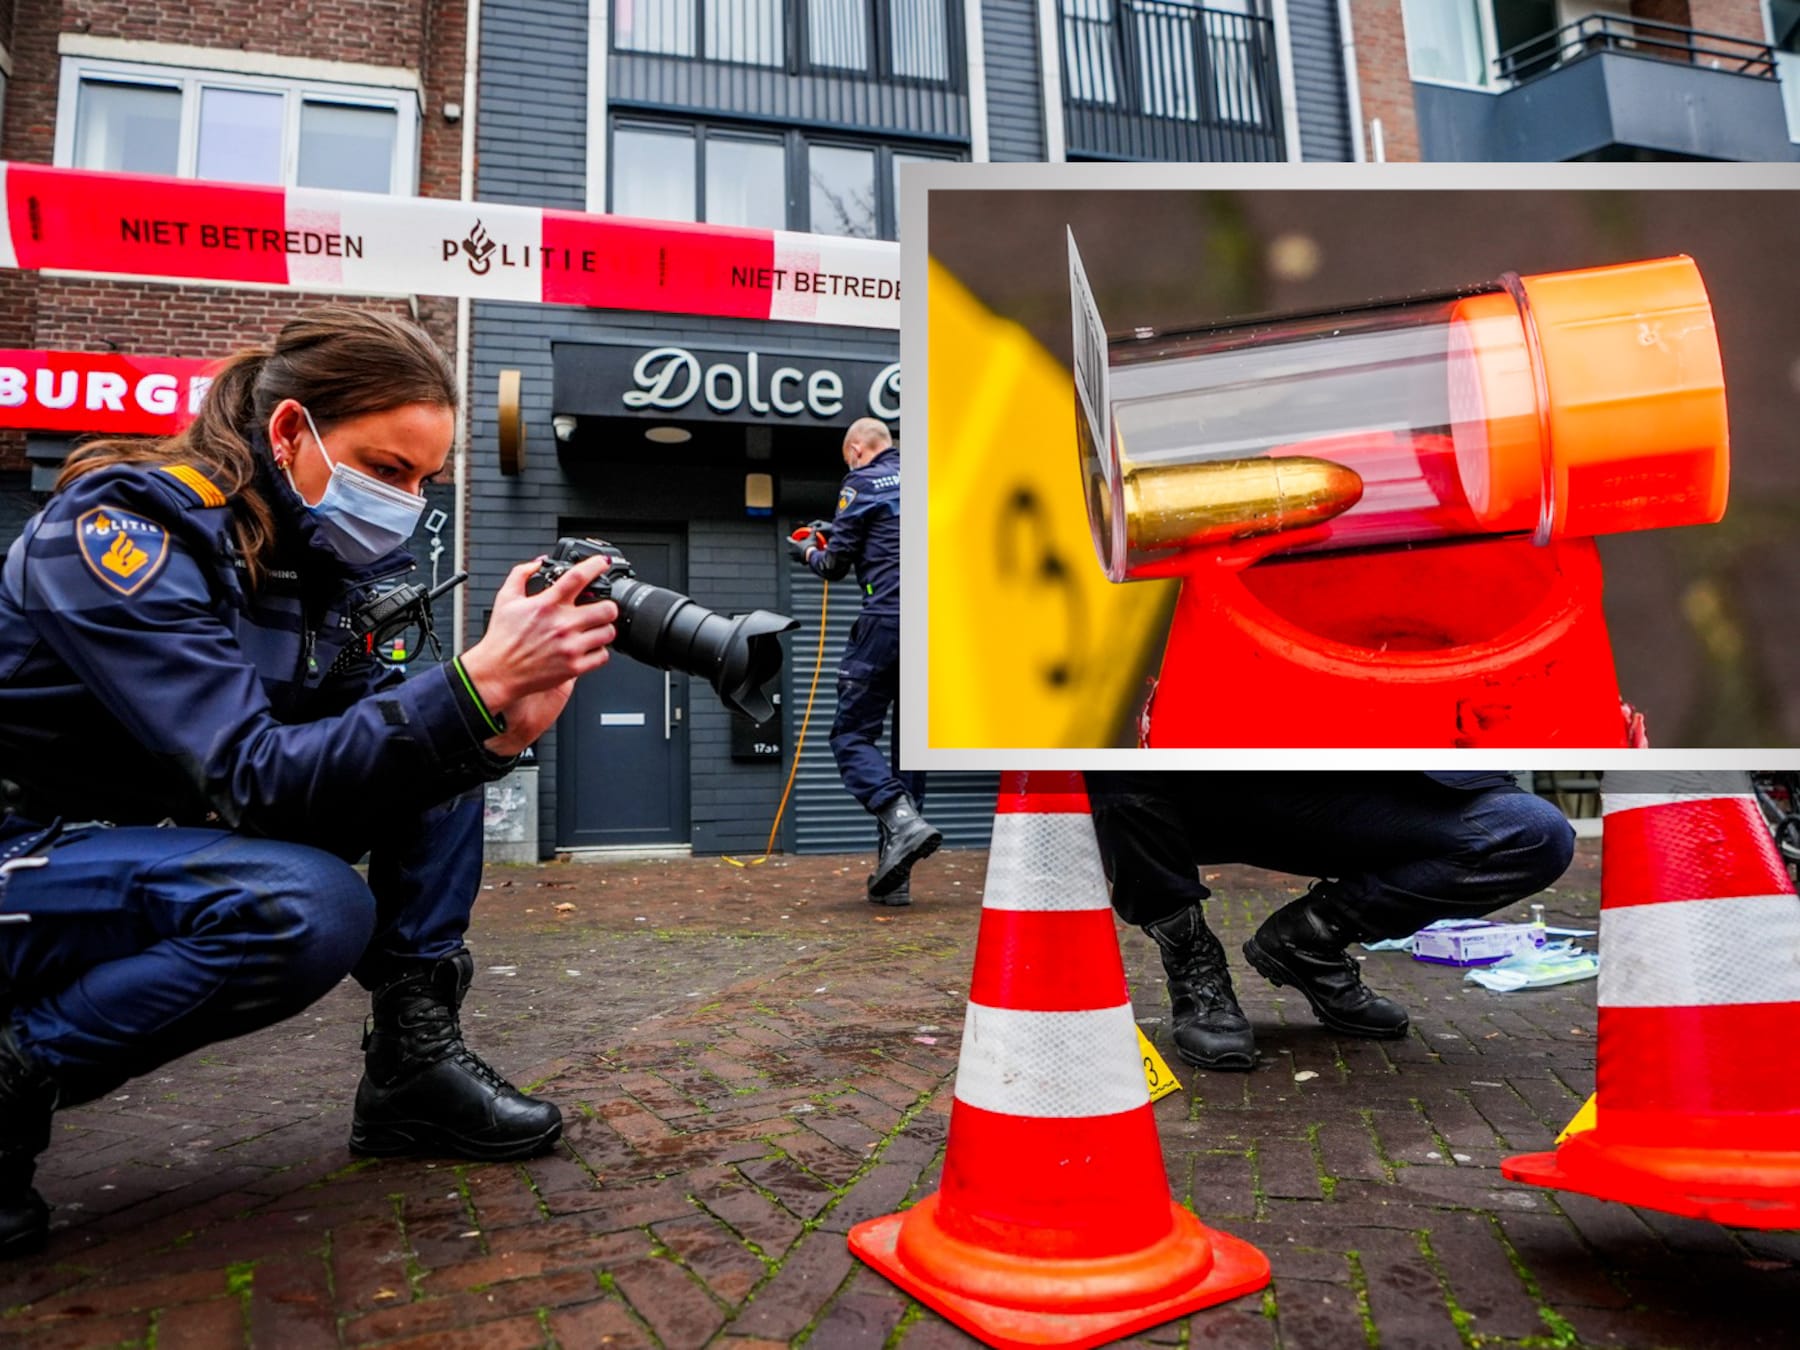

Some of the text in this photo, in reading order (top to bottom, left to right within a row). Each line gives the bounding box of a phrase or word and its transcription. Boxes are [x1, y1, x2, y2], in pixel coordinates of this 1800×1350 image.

[120, 218, 363, 259] NIET BETREDEN
[442, 234, 597, 276] POLITIE
[732, 266, 787, 290] NIET
[623, 347, 844, 416] Dolce
[85, 519, 159, 536] POLITIE
[1144, 1056, 1159, 1087] 3
